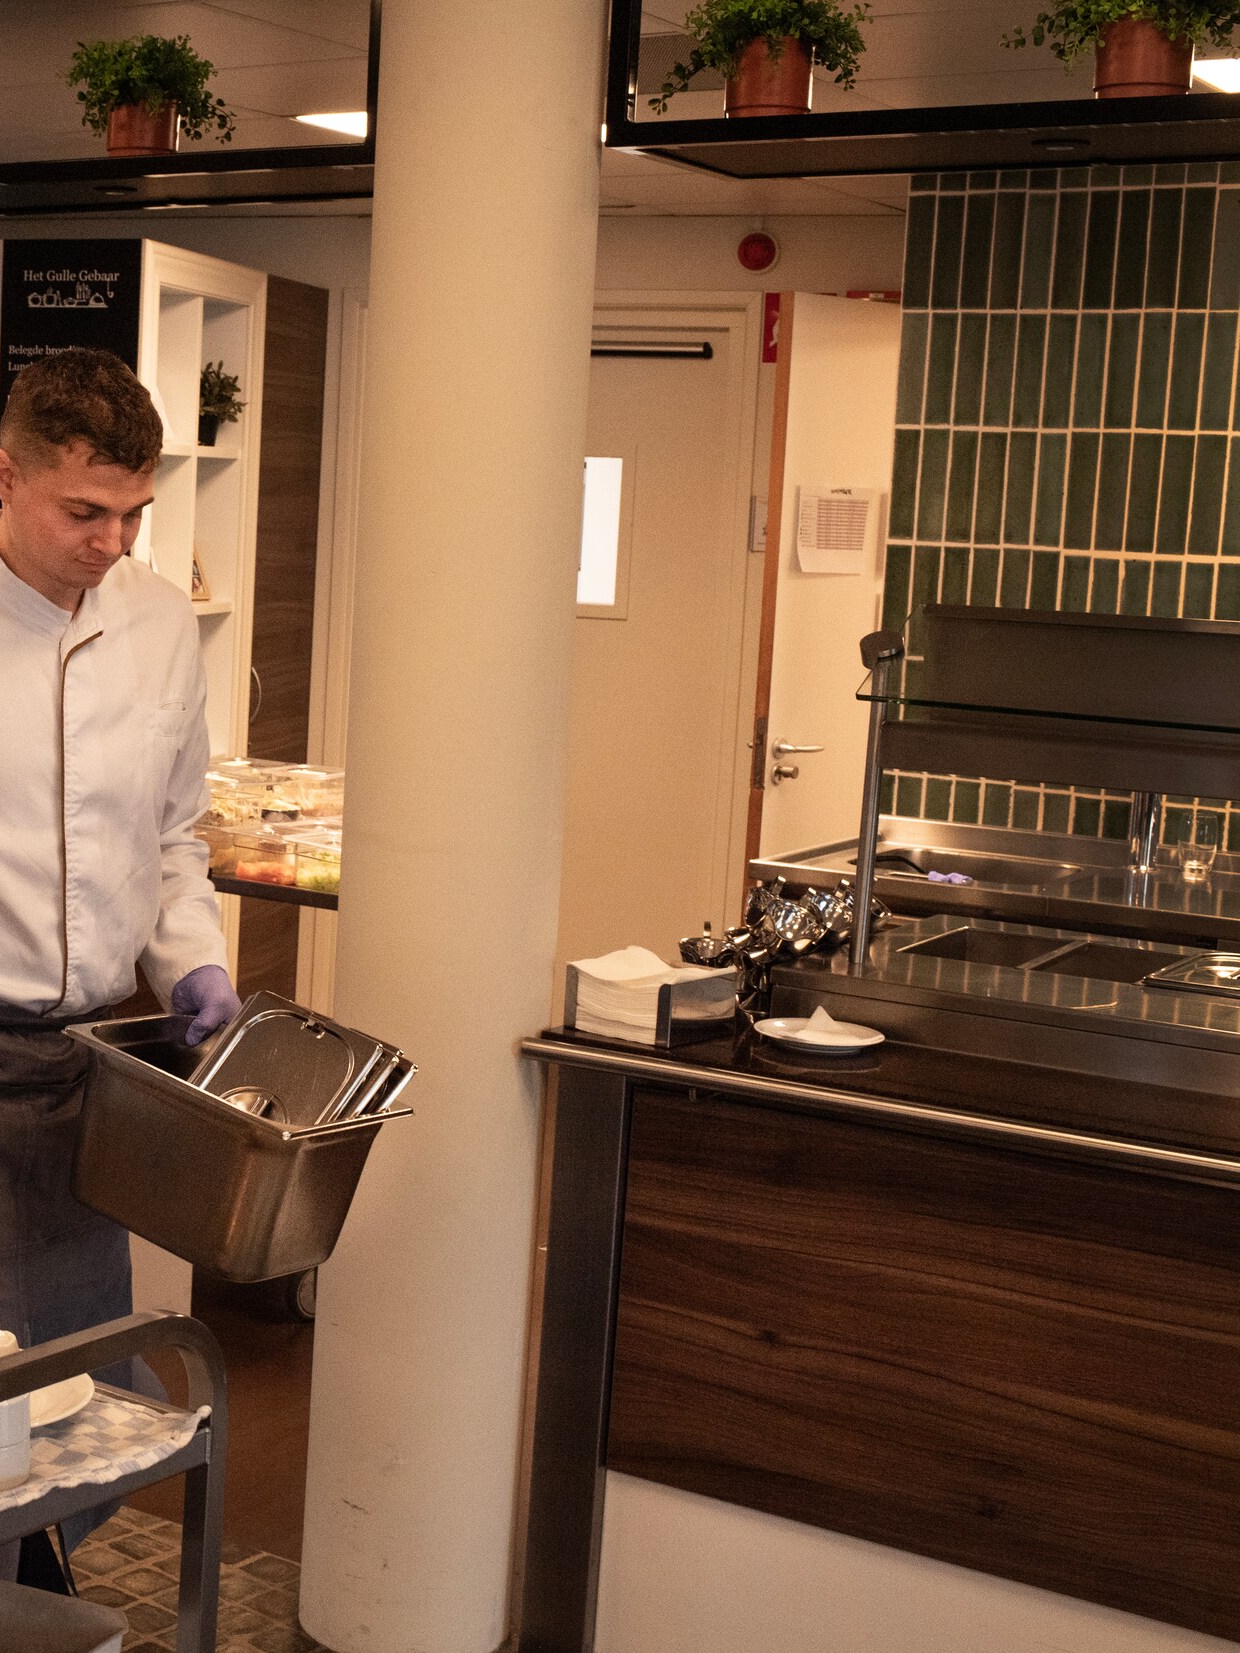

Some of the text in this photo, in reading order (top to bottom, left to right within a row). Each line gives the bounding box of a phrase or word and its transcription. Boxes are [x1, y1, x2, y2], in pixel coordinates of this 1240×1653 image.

[23, 269, 120, 281] Het Gulle Gebaar
[8, 344, 44, 356] Belegde
